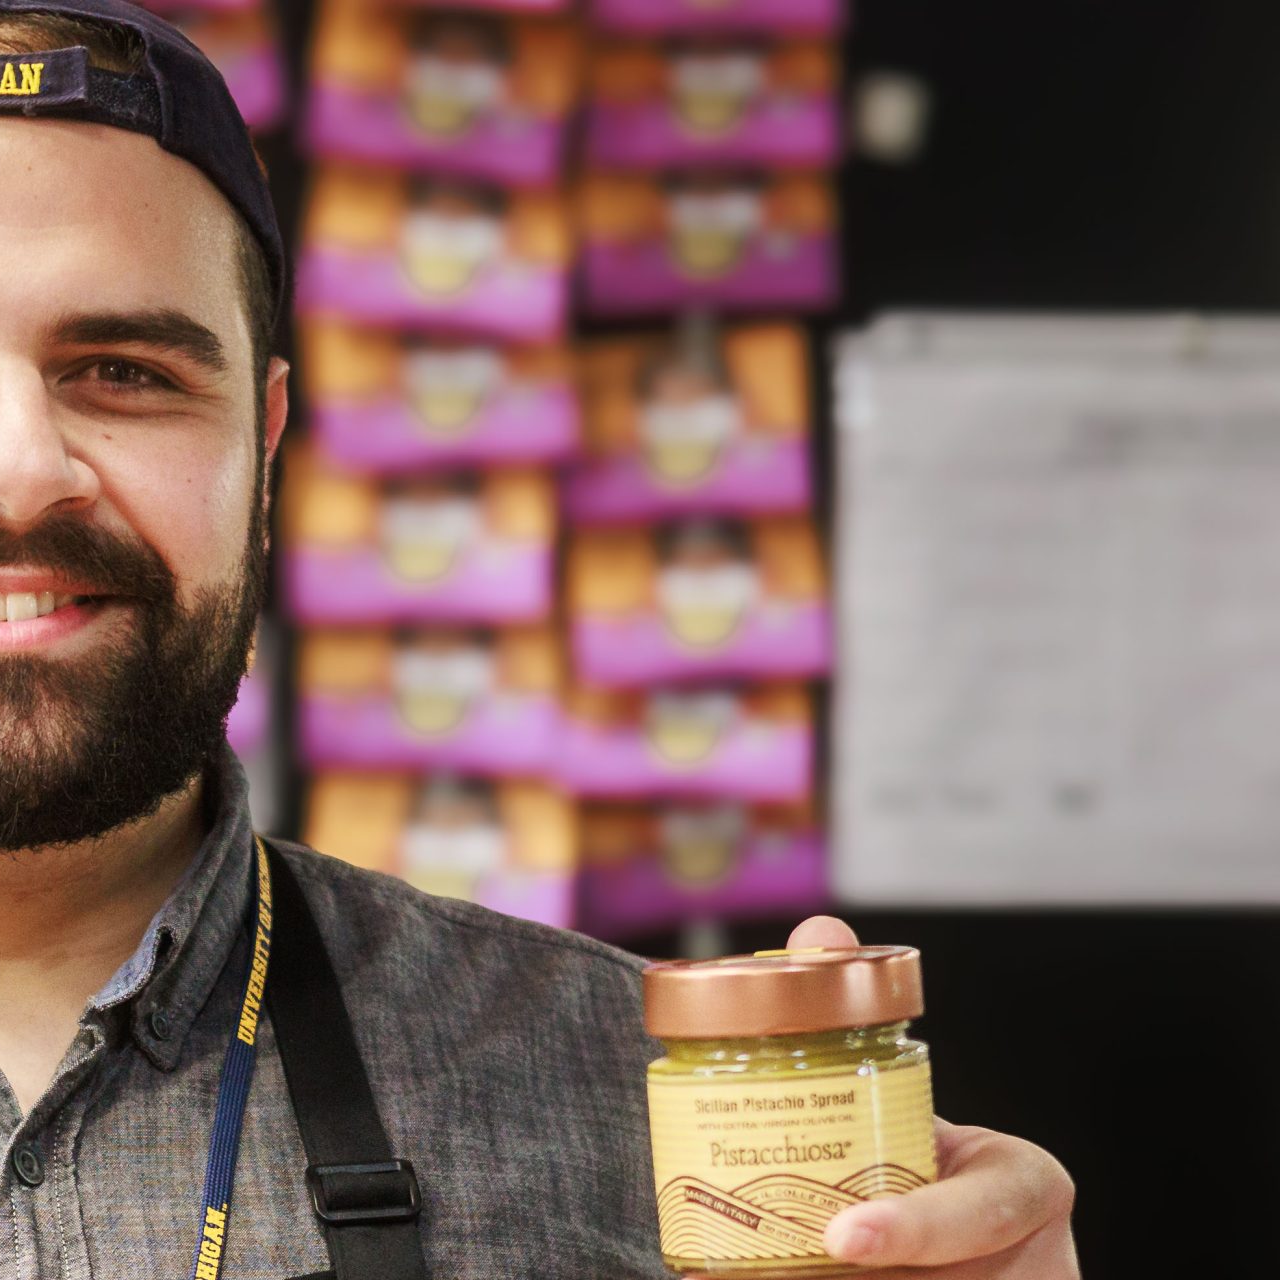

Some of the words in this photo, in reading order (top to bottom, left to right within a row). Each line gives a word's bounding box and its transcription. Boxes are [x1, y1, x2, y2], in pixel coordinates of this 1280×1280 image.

[236, 924, 271, 1046] UNIVERSITY
[694, 1098, 738, 1114] Sicilian
[743, 1096, 805, 1112] Pistachio
[810, 1090, 855, 1109] Spread
